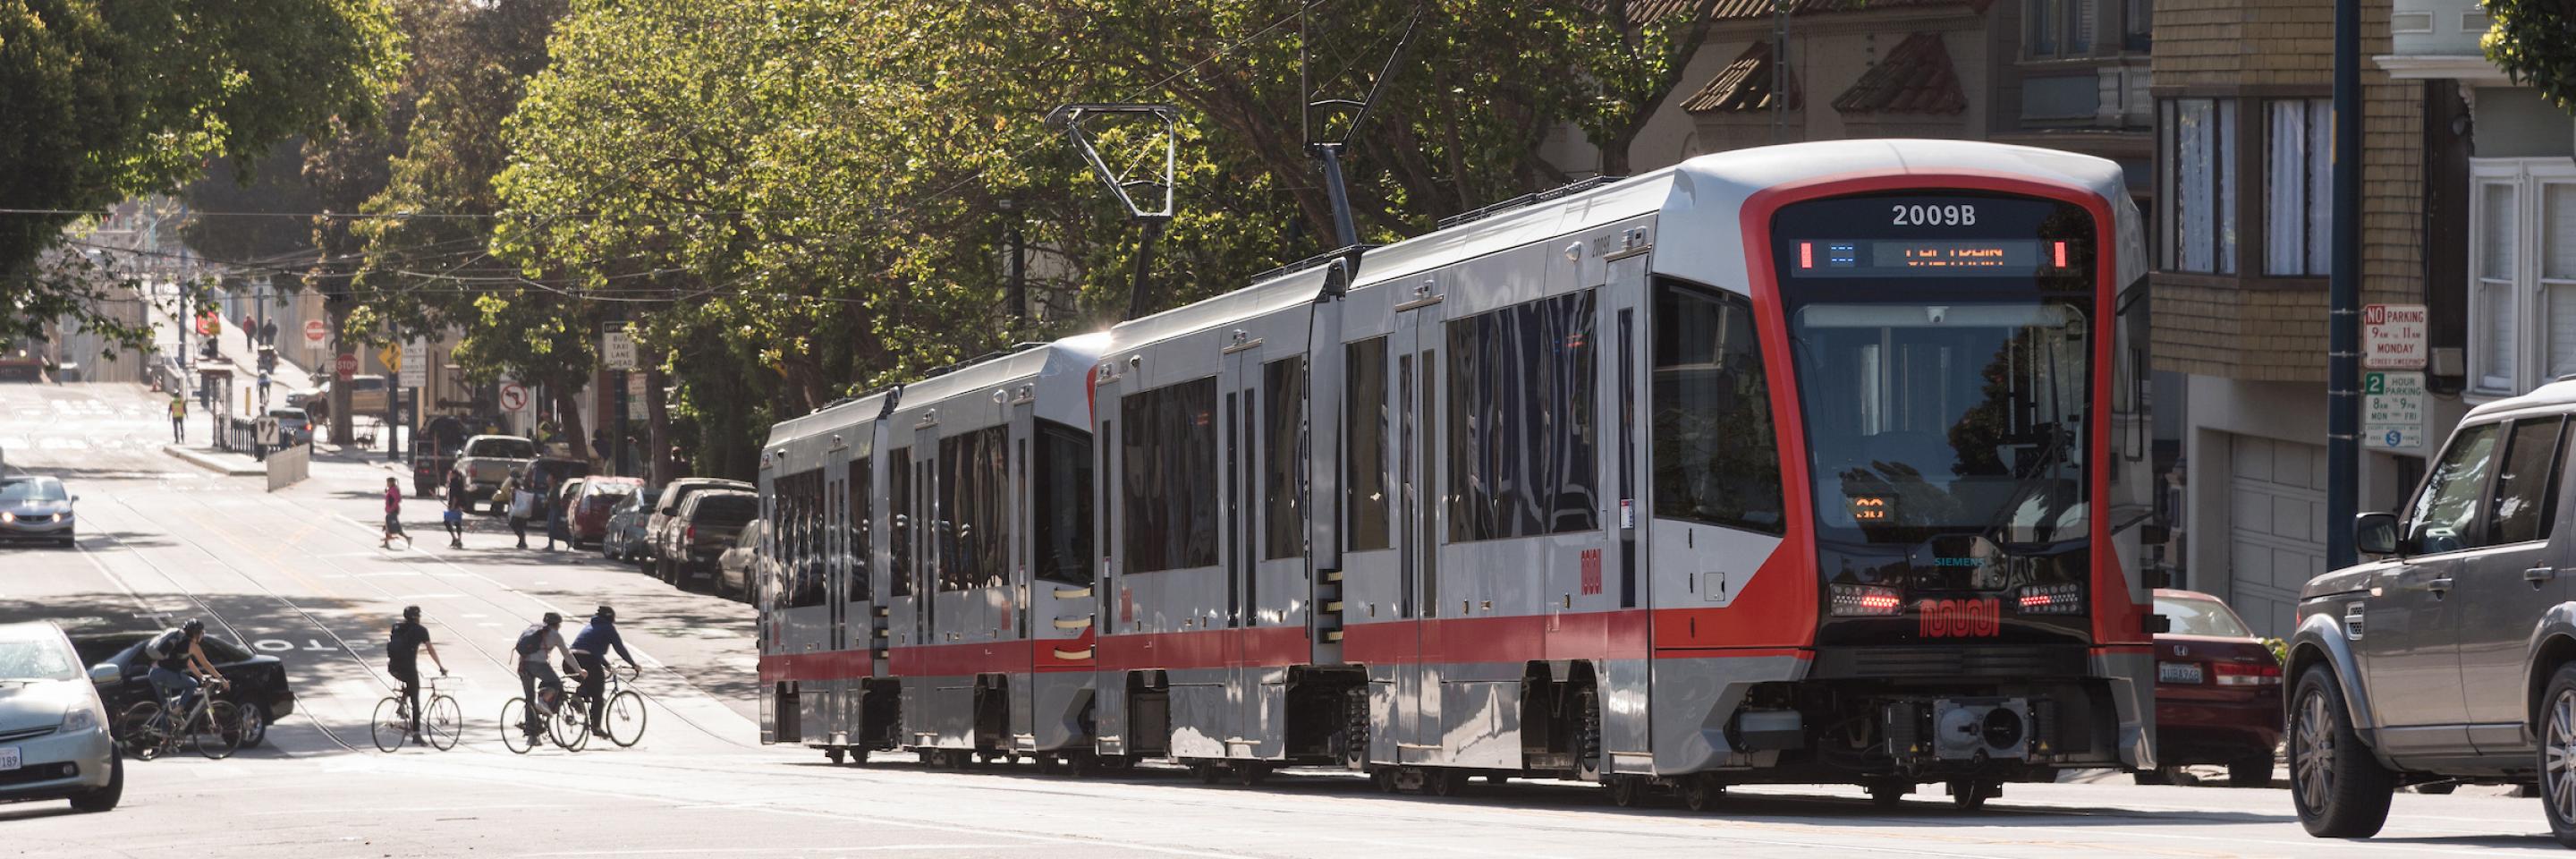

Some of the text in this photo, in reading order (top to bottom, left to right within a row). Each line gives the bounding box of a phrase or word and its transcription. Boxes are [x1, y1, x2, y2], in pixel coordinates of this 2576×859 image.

[1892, 204, 1976, 225] 2009B
[2367, 307, 2424, 323] NO PARKING
[2377, 343, 2414, 353] MONDAY
[611, 351, 630, 359] LANE
[336, 362, 356, 370] STOP
[2369, 376, 2379, 392] 2
[2392, 378, 2415, 387] HOUR
[2385, 387, 2421, 395] PARKING
[2371, 412, 2388, 421] MON
[2404, 412, 2417, 421] FRI
[2390, 432, 2398, 443] S
[1935, 557, 1986, 566] SIEMENS
